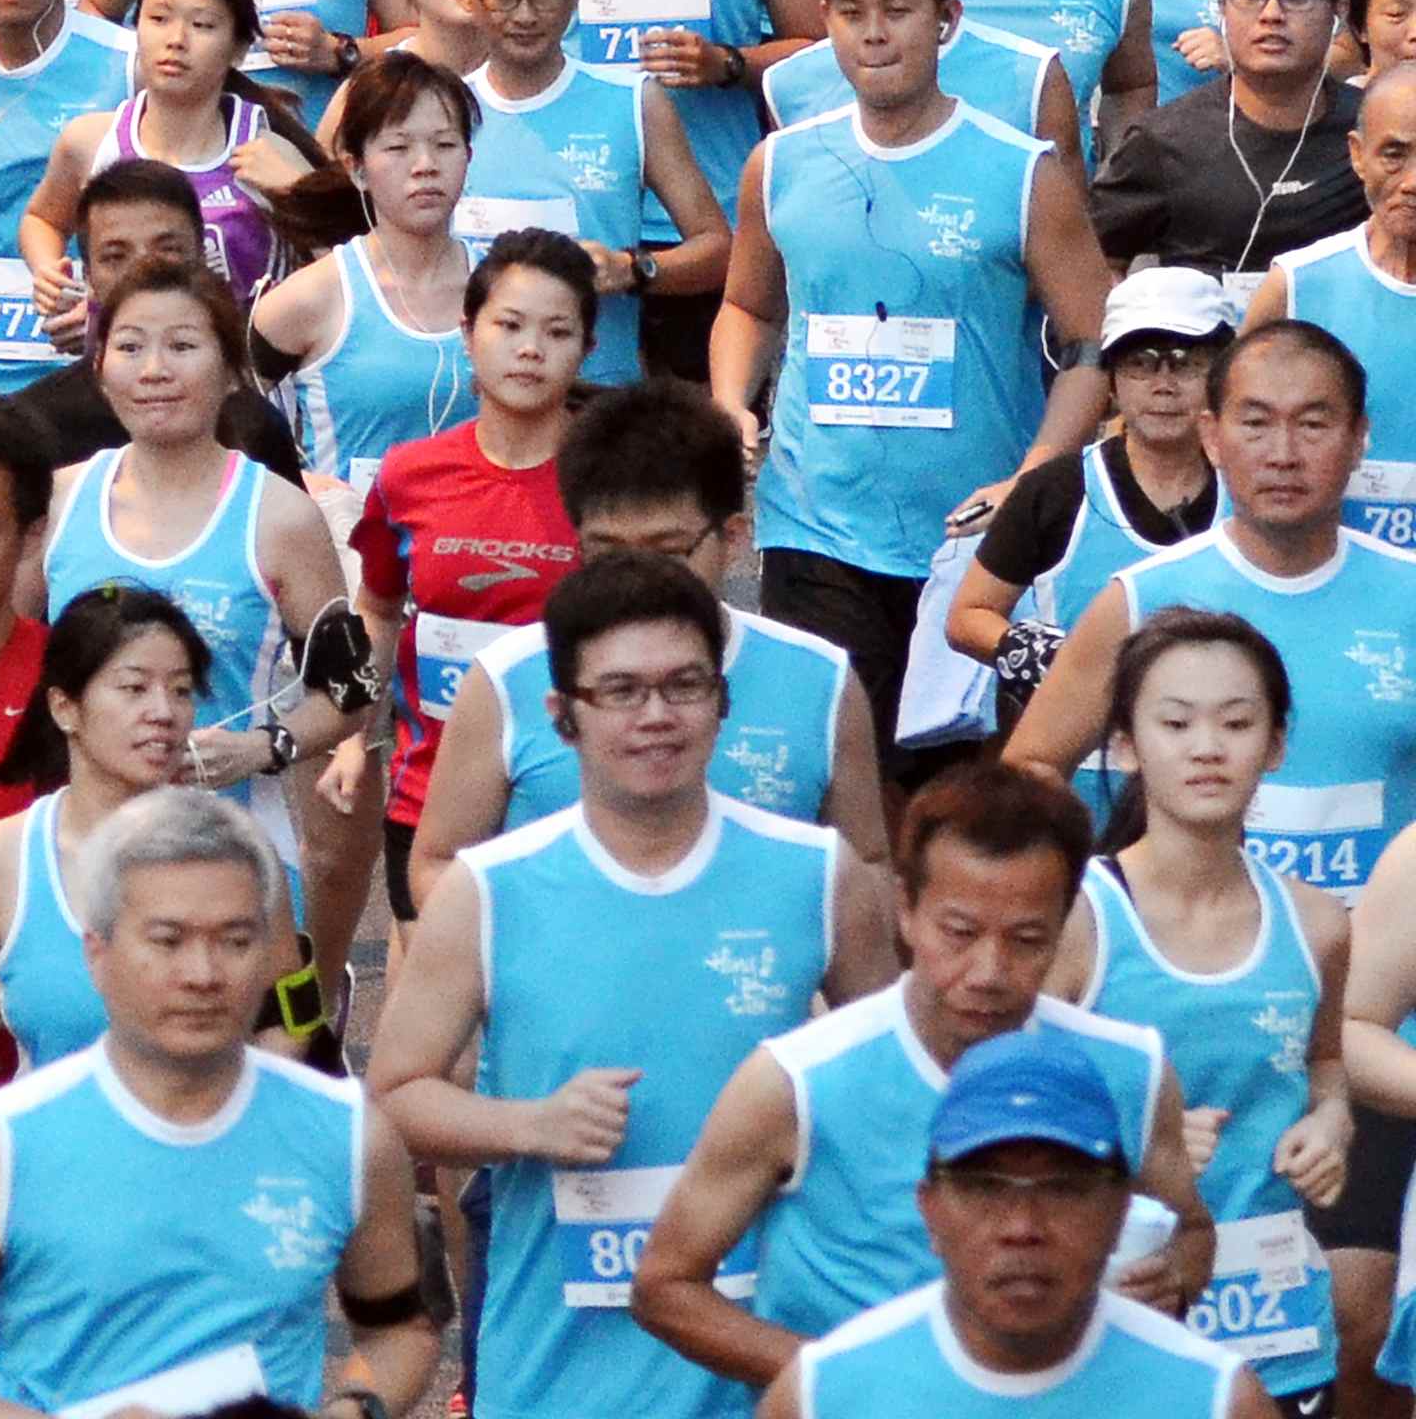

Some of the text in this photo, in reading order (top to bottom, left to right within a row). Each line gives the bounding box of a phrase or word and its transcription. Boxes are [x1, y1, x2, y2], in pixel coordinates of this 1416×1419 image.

[826, 362, 929, 402] 8327
[1364, 506, 1416, 544] 78
[434, 536, 574, 562] BROOKS
